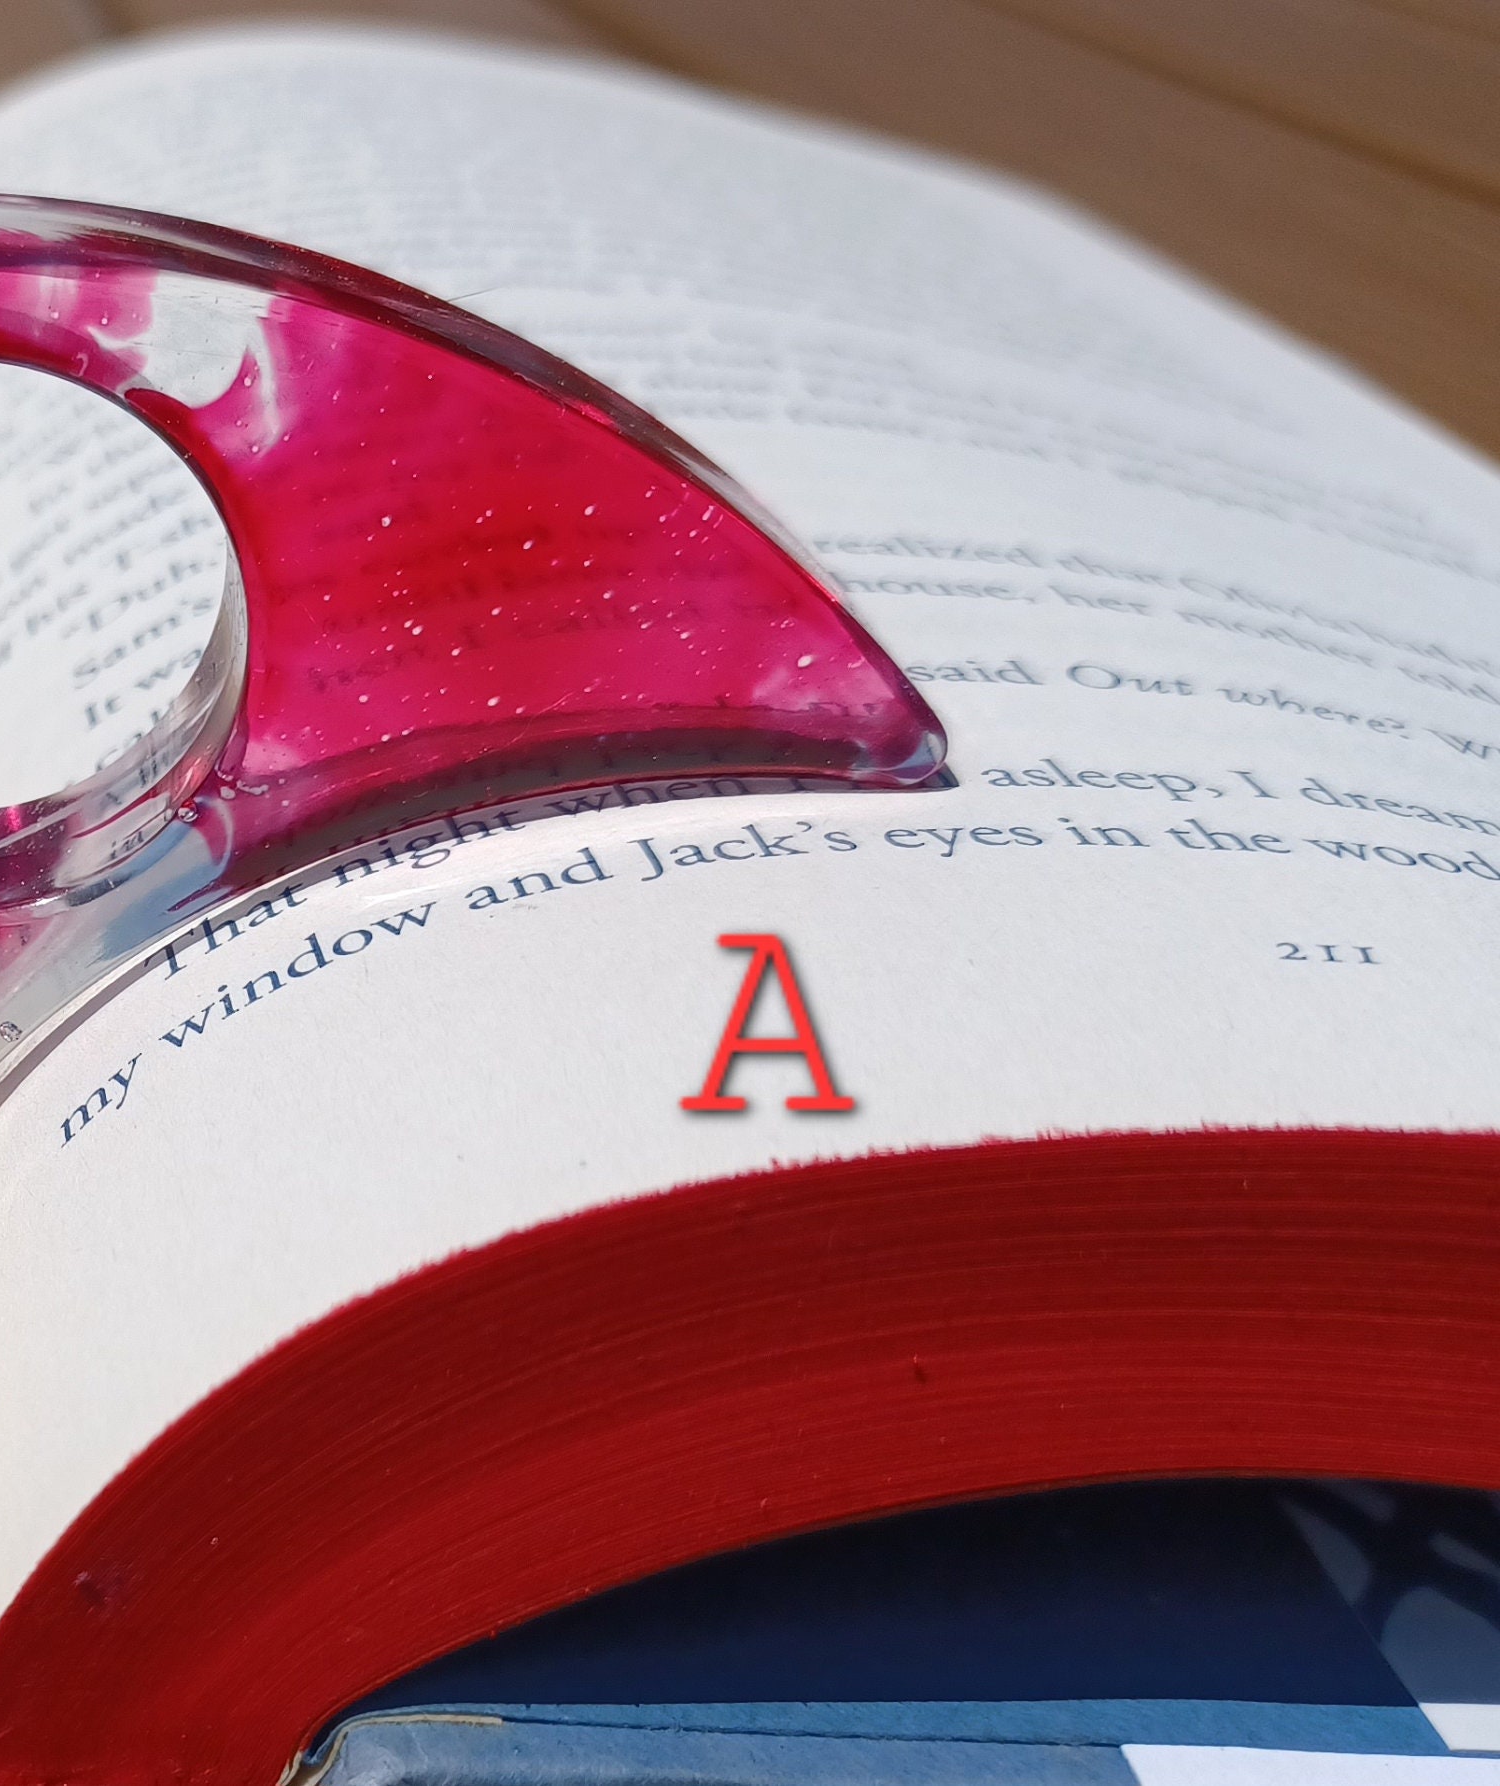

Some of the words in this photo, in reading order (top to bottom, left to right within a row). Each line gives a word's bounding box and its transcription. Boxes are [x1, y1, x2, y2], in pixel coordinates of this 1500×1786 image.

[902, 659, 1045, 688] said
[1065, 663, 1196, 699] Out
[1214, 687, 1411, 741] where?
[142, 880, 308, 981] That
[332, 810, 528, 889] night
[543, 775, 751, 819] when
[980, 758, 1224, 803] asleep,
[1227, 769, 1281, 801] I
[60, 1051, 144, 1149] my
[157, 900, 438, 1049] window
[463, 846, 616, 911] and
[626, 821, 859, 883] Jack's
[883, 821, 1045, 858] eyes
[1057, 816, 1151, 850] in
[1164, 817, 1292, 855] the
[1300, 837, 1500, 882] wood
[1275, 941, 1382, 965] 211
